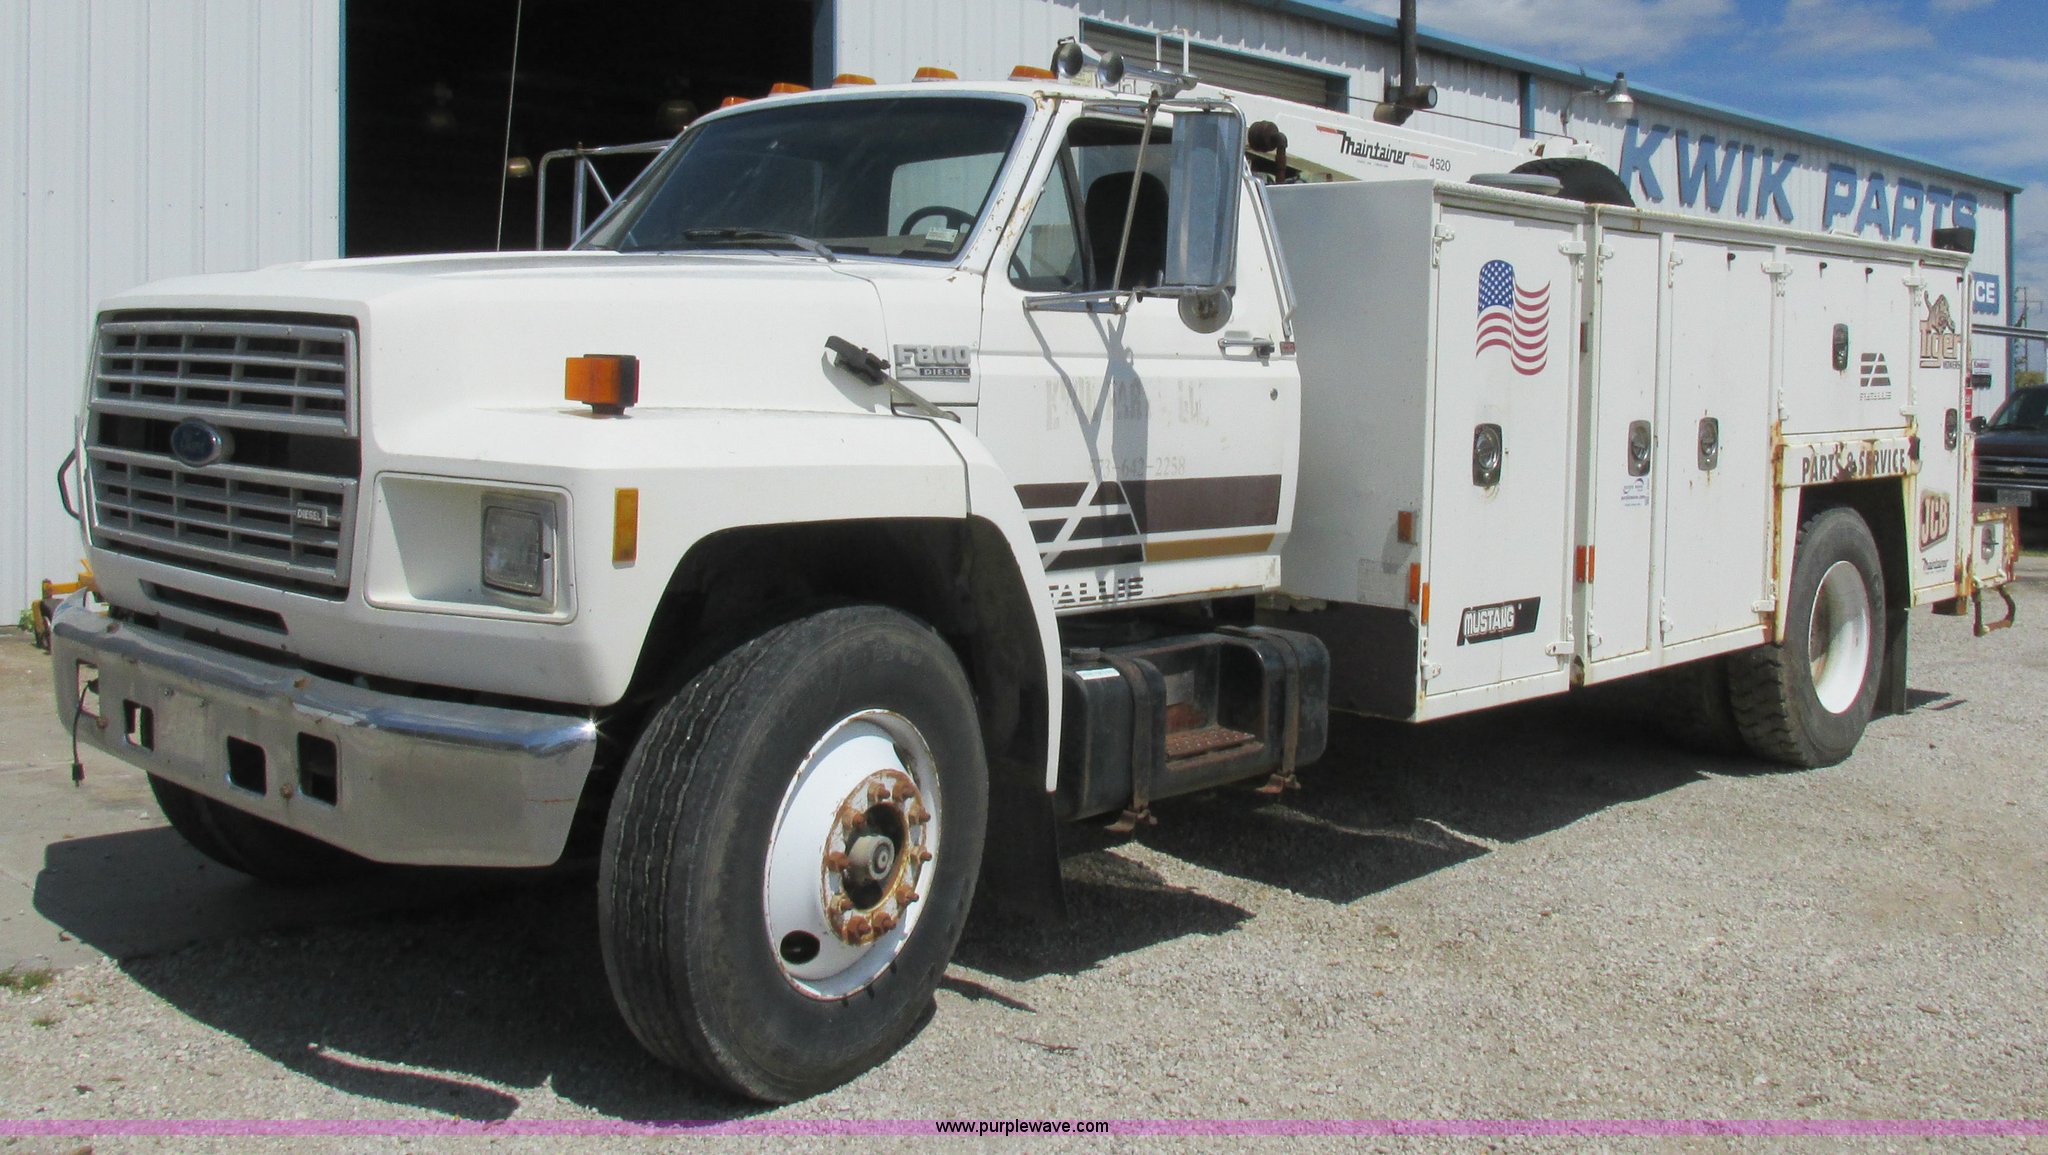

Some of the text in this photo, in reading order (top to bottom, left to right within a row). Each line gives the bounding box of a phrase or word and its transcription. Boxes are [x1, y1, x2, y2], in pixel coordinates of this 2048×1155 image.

[1337, 130, 1410, 165] Maintainer
[1429, 158, 1451, 172] 4520
[1619, 119, 1978, 243] KWIK PARTS
[923, 368, 969, 377] DIESEL
[296, 508, 322, 521] DIESEL
[1921, 496, 1949, 544] JCB
[1464, 604, 1515, 636] MUSTANG
